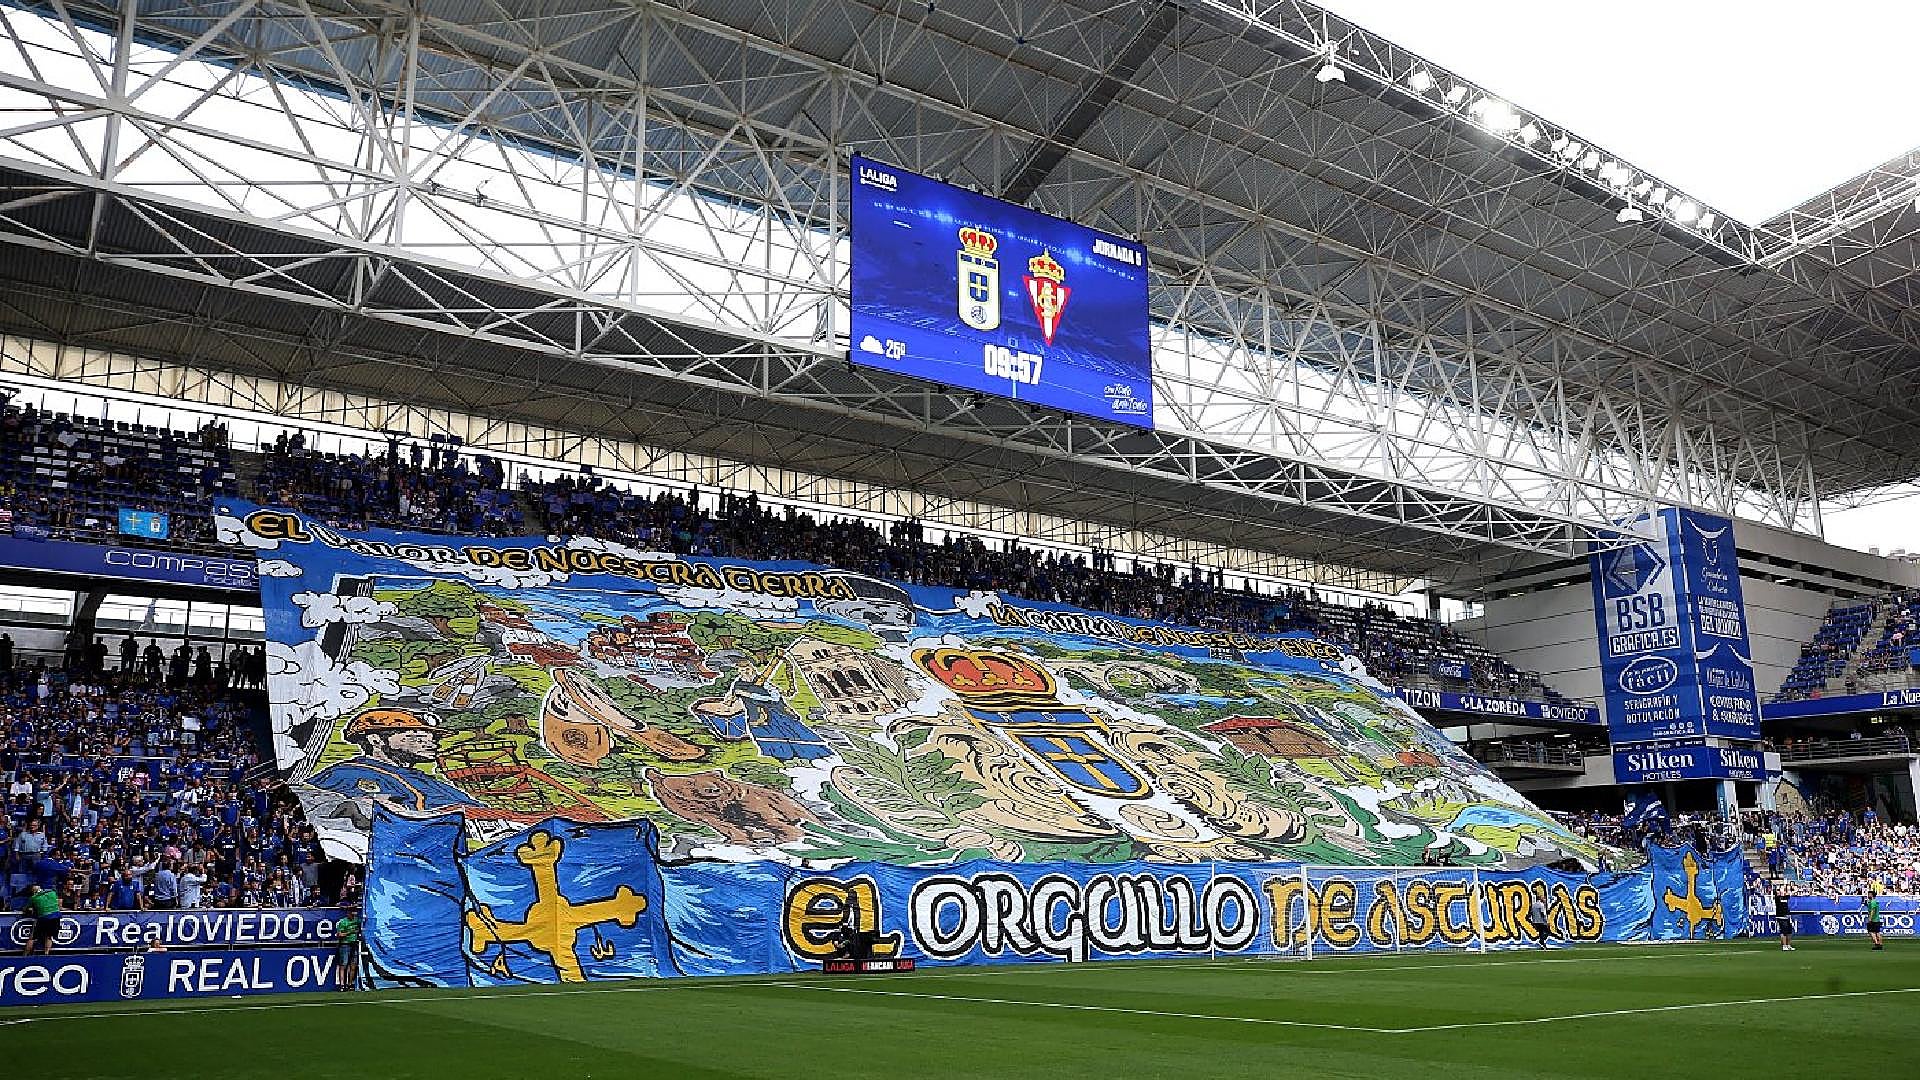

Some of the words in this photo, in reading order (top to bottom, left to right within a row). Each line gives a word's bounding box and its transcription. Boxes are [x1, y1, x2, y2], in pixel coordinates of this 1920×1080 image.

[860, 165, 897, 187] LALIGA
[1093, 239, 1135, 264] JORNADA
[984, 344, 1043, 385] 09:57
[104, 550, 259, 581] compas
[247, 510, 313, 542] EL
[463, 547, 533, 571] DE
[534, 547, 726, 591] NUESTRA
[721, 567, 858, 601] TIERRA
[1616, 592, 1666, 632] BSB
[1153, 626, 1270, 653] NUESTR
[1612, 628, 1678, 654] GRAFICA.ES
[1403, 688, 1440, 708] TIZON
[1485, 699, 1527, 716] ZOREDA
[1882, 692, 1898, 706] La
[1627, 751, 1695, 772] Silken
[1720, 748, 1759, 769] Silken
[782, 874, 903, 959] EL
[911, 873, 1262, 963] ORGULLO
[1262, 874, 1361, 948] DE
[1842, 914, 1914, 929] OVDO
[0, 964, 89, 996] rea
[168, 957, 274, 993] REAL
